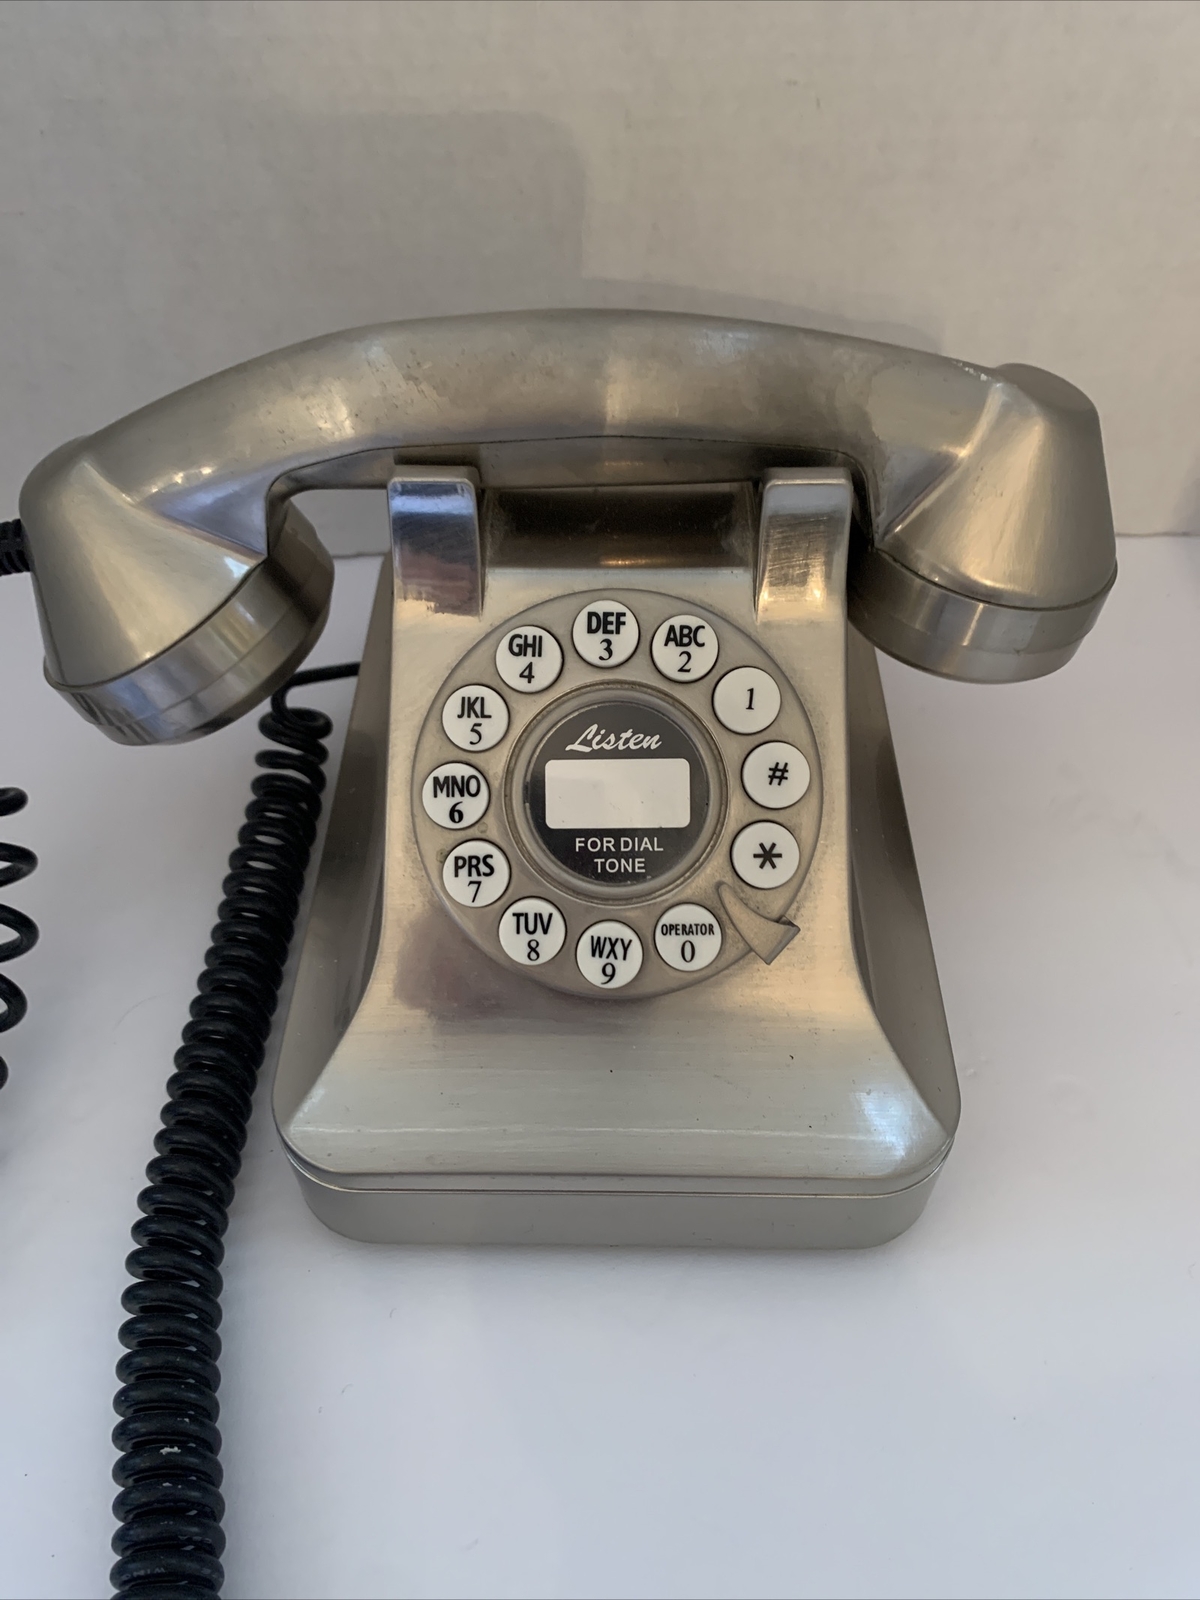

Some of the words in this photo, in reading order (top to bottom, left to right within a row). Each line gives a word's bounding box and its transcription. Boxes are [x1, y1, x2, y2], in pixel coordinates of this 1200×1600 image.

[587, 611, 627, 635] DEF
[508, 634, 543, 658] GHI
[663, 624, 706, 648] ABC
[599, 639, 614, 661] 3
[518, 661, 535, 684] 4
[677, 651, 692, 673] 2
[456, 696, 492, 719] JKL
[745, 687, 755, 711] 1
[469, 723, 483, 746] 5
[564, 723, 662, 753] Listen
[432, 774, 481, 799] MNO
[448, 801, 464, 824] 6
[575, 837, 616, 852] FOR
[620, 837, 664, 852] DIAL
[453, 854, 495, 878] PRS
[593, 858, 646, 873] TONE
[467, 880, 482, 903] 7
[511, 912, 554, 936] TUV
[660, 923, 715, 937] OPERATOR
[526, 938, 541, 962] 8
[590, 935, 633, 962] WXY
[680, 940, 696, 963] 0
[600, 962, 617, 985] 9
